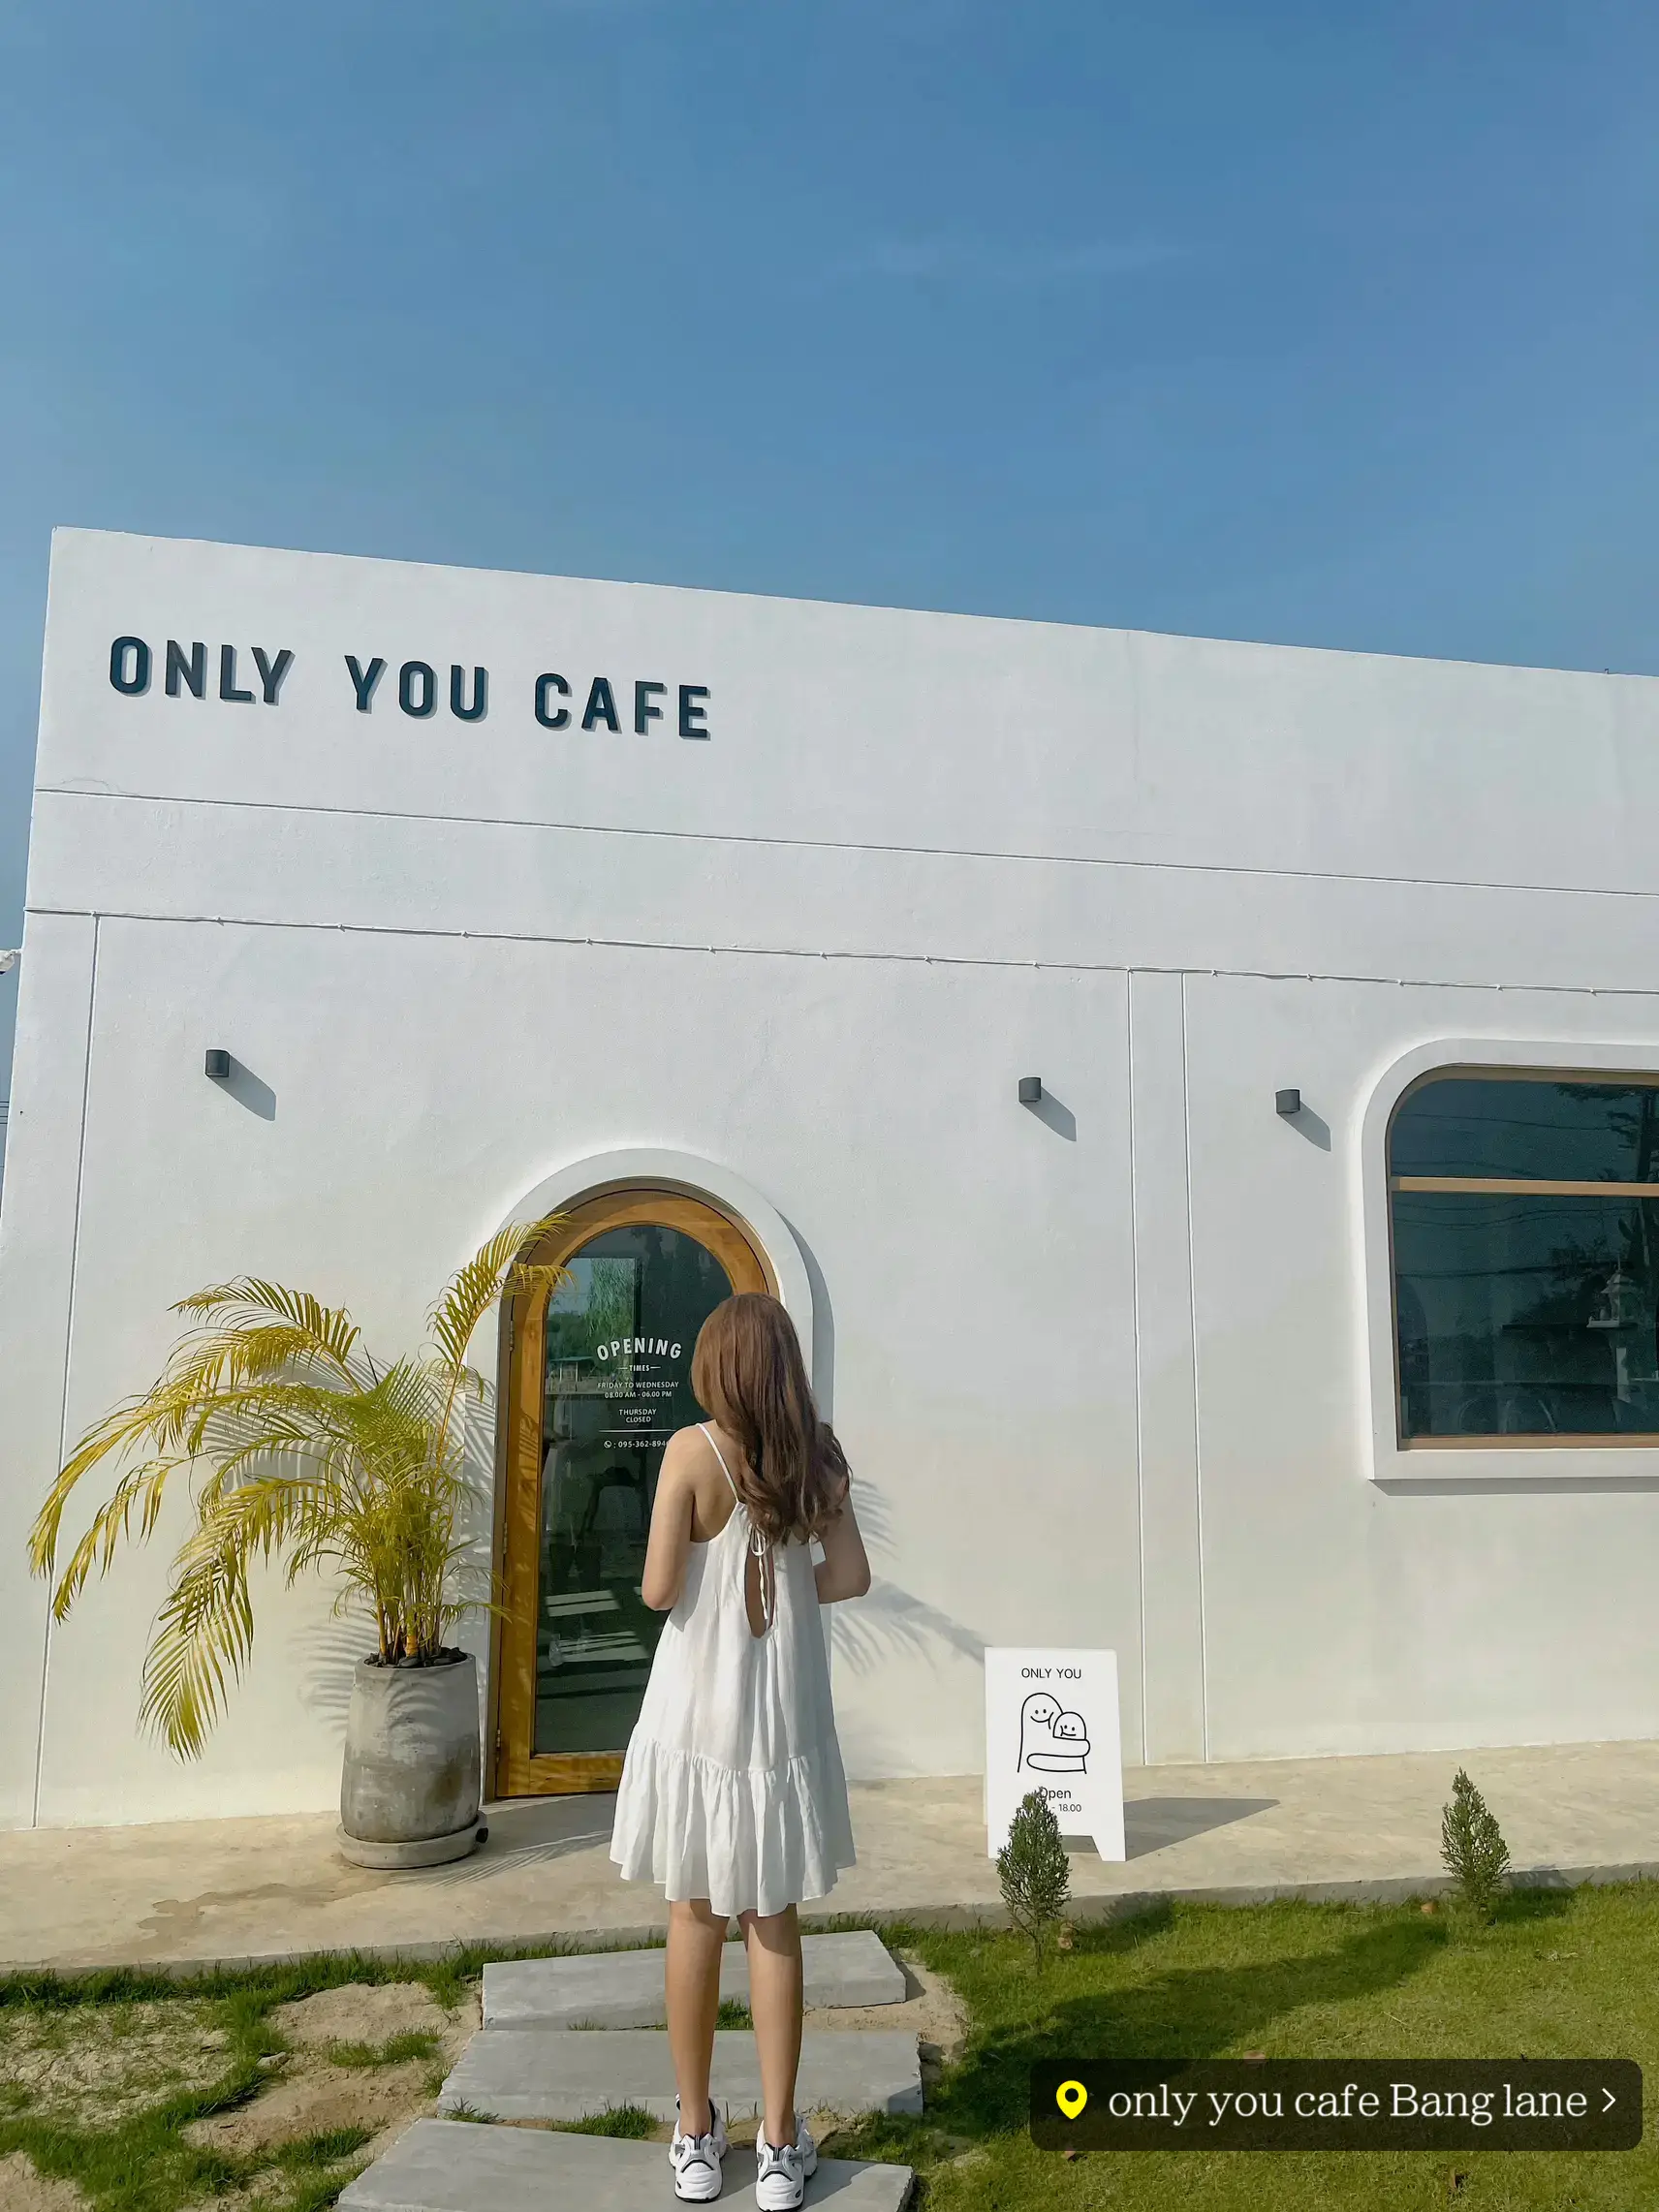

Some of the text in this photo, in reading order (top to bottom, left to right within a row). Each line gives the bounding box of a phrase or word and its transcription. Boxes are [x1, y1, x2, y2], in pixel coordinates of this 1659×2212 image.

[109, 636, 711, 740] ONLY YOU CAFE
[597, 1337, 682, 1361] OPENING
[1020, 1667, 1082, 1679] ONLY YOU
[1039, 1787, 1072, 1801] Open
[1058, 1803, 1082, 1812] 18.00
